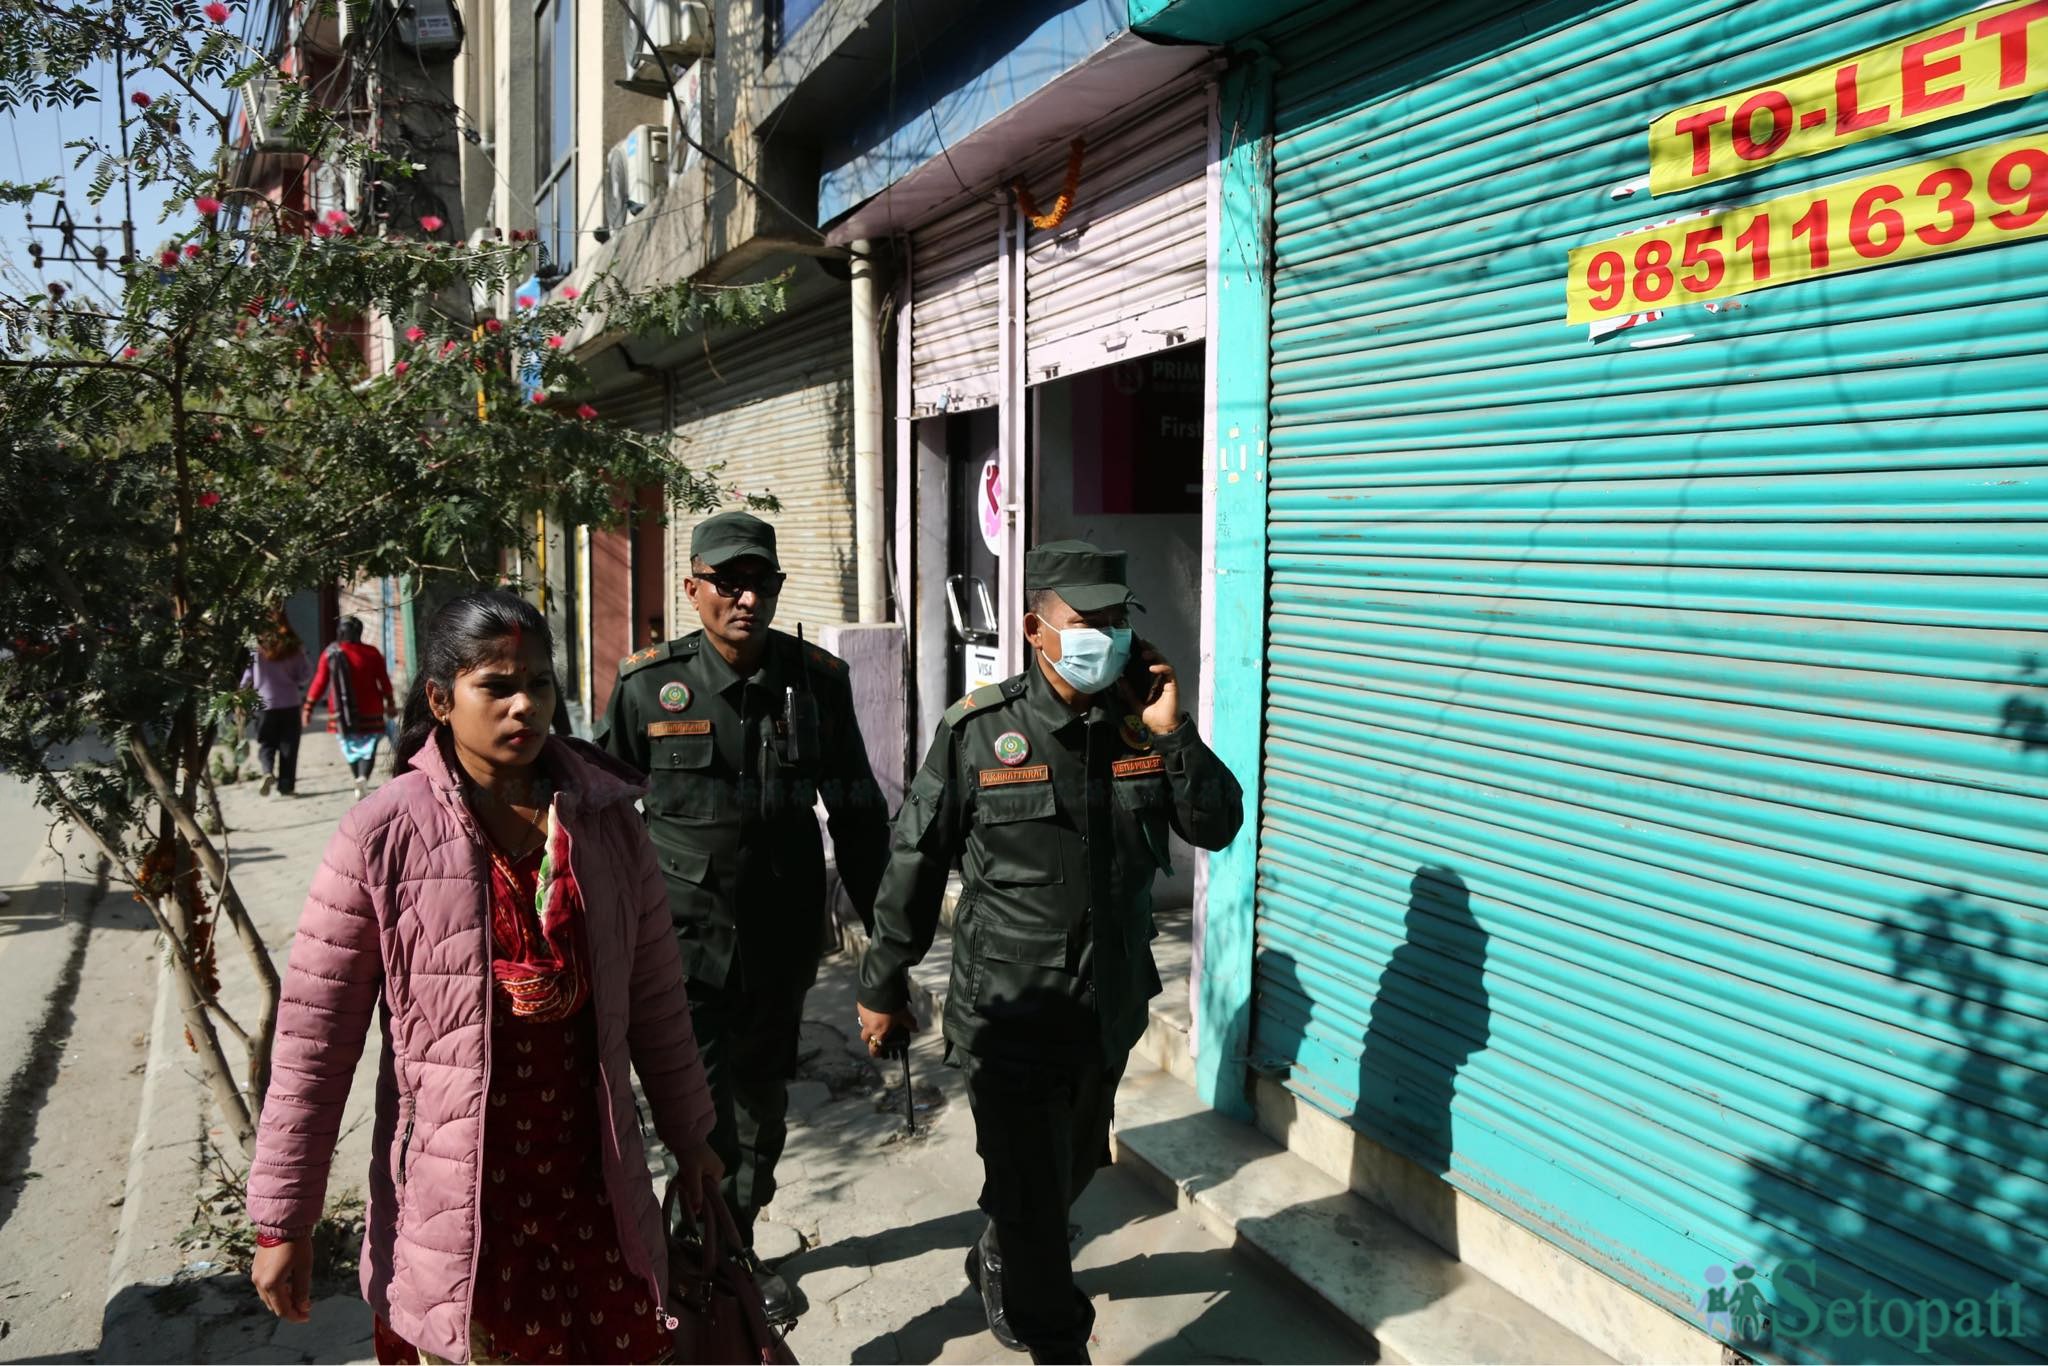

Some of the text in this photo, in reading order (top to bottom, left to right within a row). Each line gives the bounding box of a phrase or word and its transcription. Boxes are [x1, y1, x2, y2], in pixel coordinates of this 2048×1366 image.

[1675, 1, 2048, 177] TO-LET
[1587, 148, 2048, 311] 98511639
[977, 662, 992, 676] VISA
